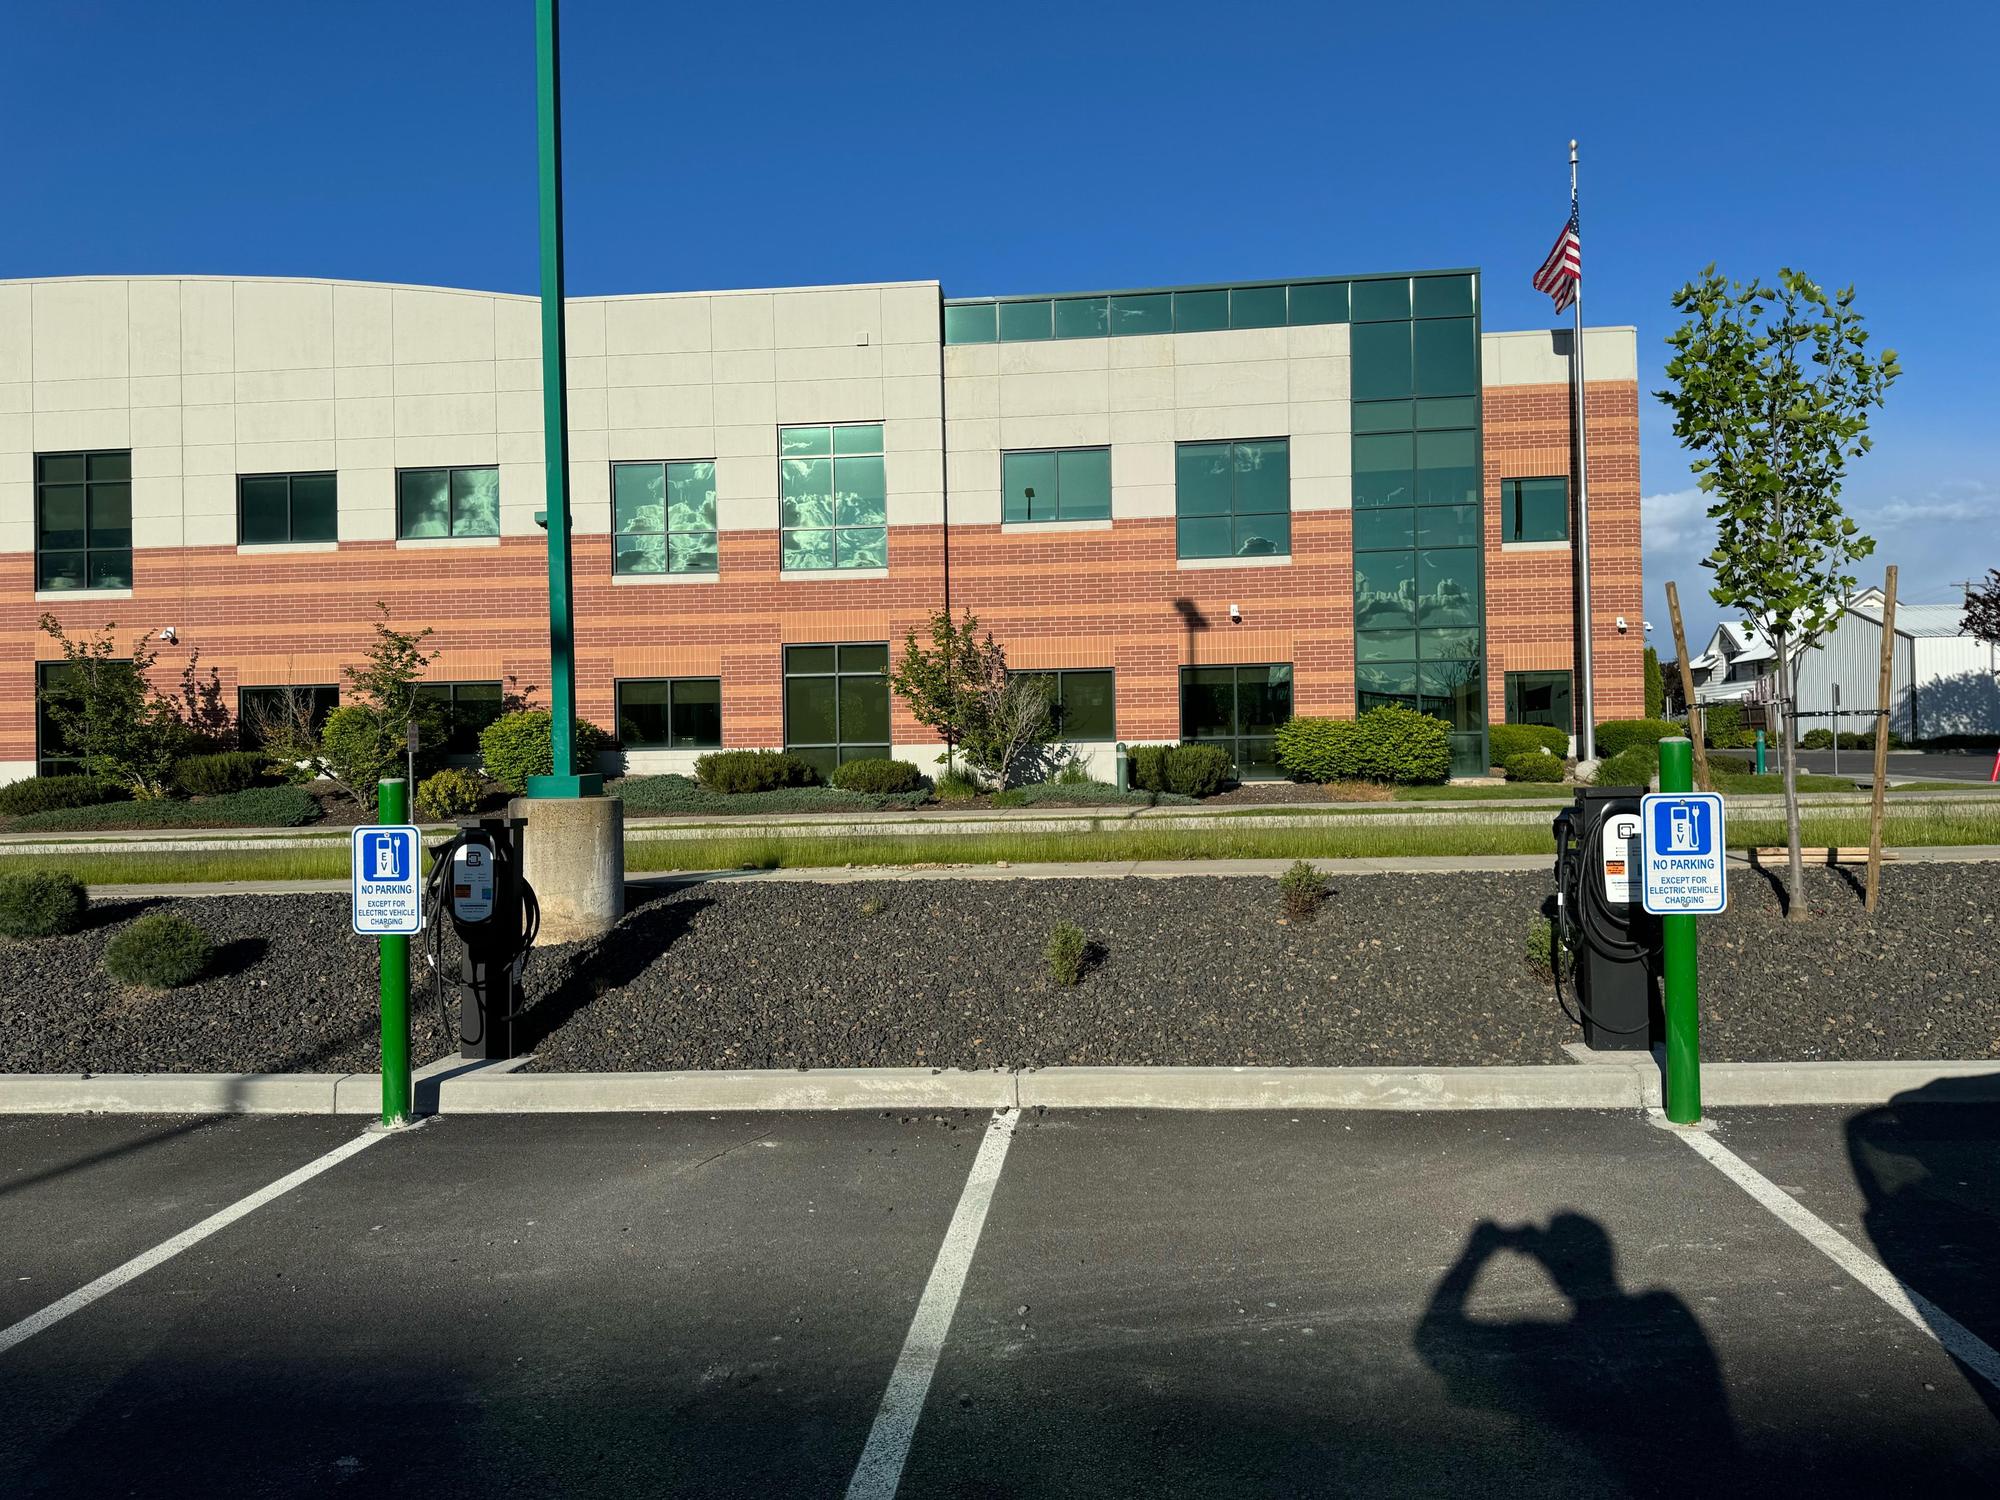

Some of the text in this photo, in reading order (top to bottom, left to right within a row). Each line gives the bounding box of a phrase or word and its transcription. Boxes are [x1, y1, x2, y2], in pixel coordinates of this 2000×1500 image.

[1653, 858, 1714, 870] NO PARKING
[1661, 876, 1690, 884] EXCEPT
[361, 884, 412, 894] NO PARKING
[1650, 886, 1718, 894] ELECTRIC VEHICLE
